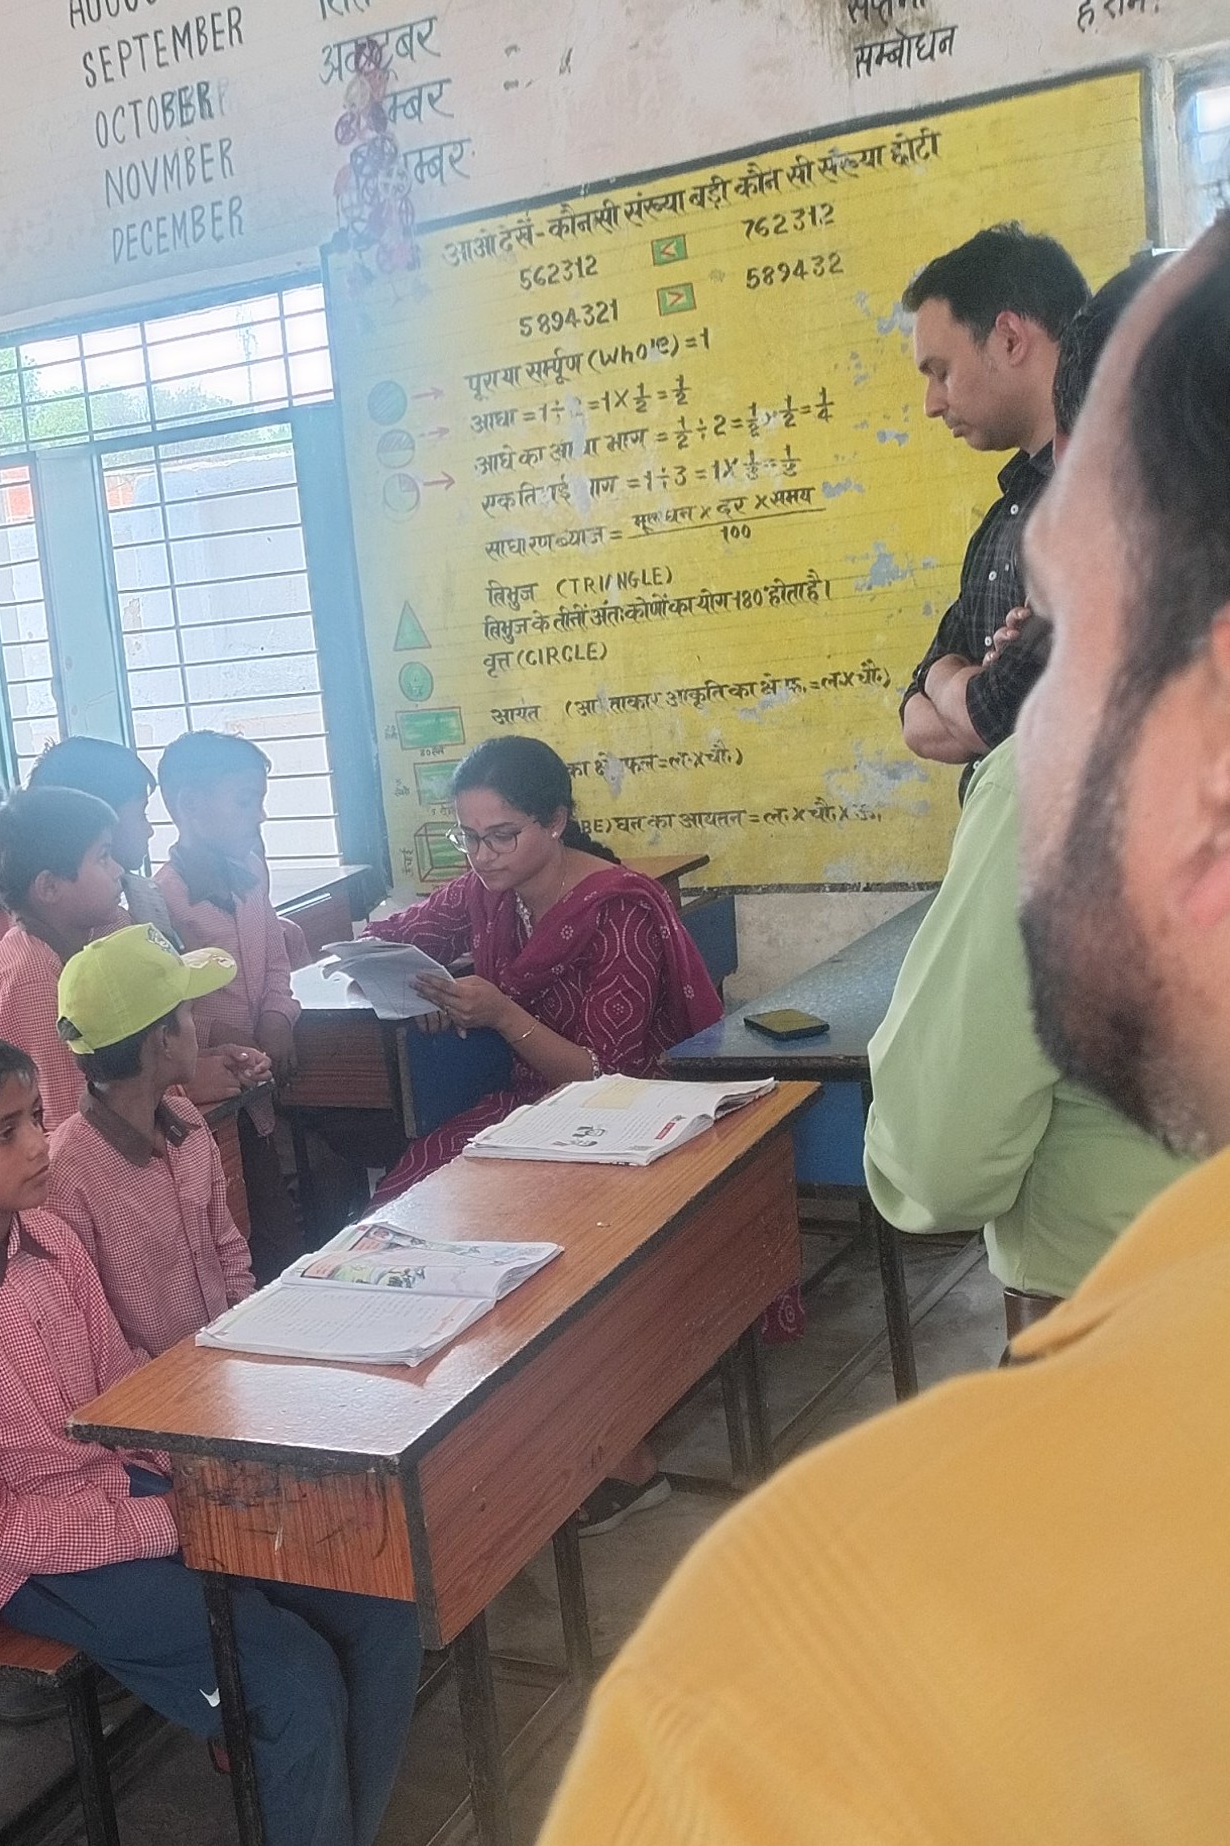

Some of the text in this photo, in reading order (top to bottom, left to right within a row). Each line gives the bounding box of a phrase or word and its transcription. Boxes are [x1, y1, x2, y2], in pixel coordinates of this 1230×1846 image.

[82, 6, 243, 88] SEPTEMBER
[853, 25, 958, 79] सम्बोधन
[95, 80, 214, 149] OCTOBER
[384, 78, 454, 123] म्बर
[105, 137, 234, 208] NOVMBER
[403, 138, 472, 184] म्बर
[624, 191, 687, 228] संख्या
[734, 161, 783, 199] कौन
[786, 154, 815, 189] सी
[113, 195, 244, 264] DECEMBER
[520, 202, 835, 291] 562312 762312
[520, 252, 844, 338] 5894321 589432
[471, 408, 518, 433] आधा
[475, 444, 515, 476] आधे
[518, 445, 547, 469] का
[485, 533, 556, 562] साधारण
[720, 524, 752, 544] 100
[531, 609, 553, 633] के
[668, 596, 696, 617] का
[697, 587, 733, 615] योग
[517, 641, 608, 669] (CIRCLE)
[566, 692, 663, 717] (आताकार
[727, 681, 758, 701] का
[579, 818, 612, 835] BE)
[647, 813, 675, 830] का
[678, 809, 747, 831] आयतन
